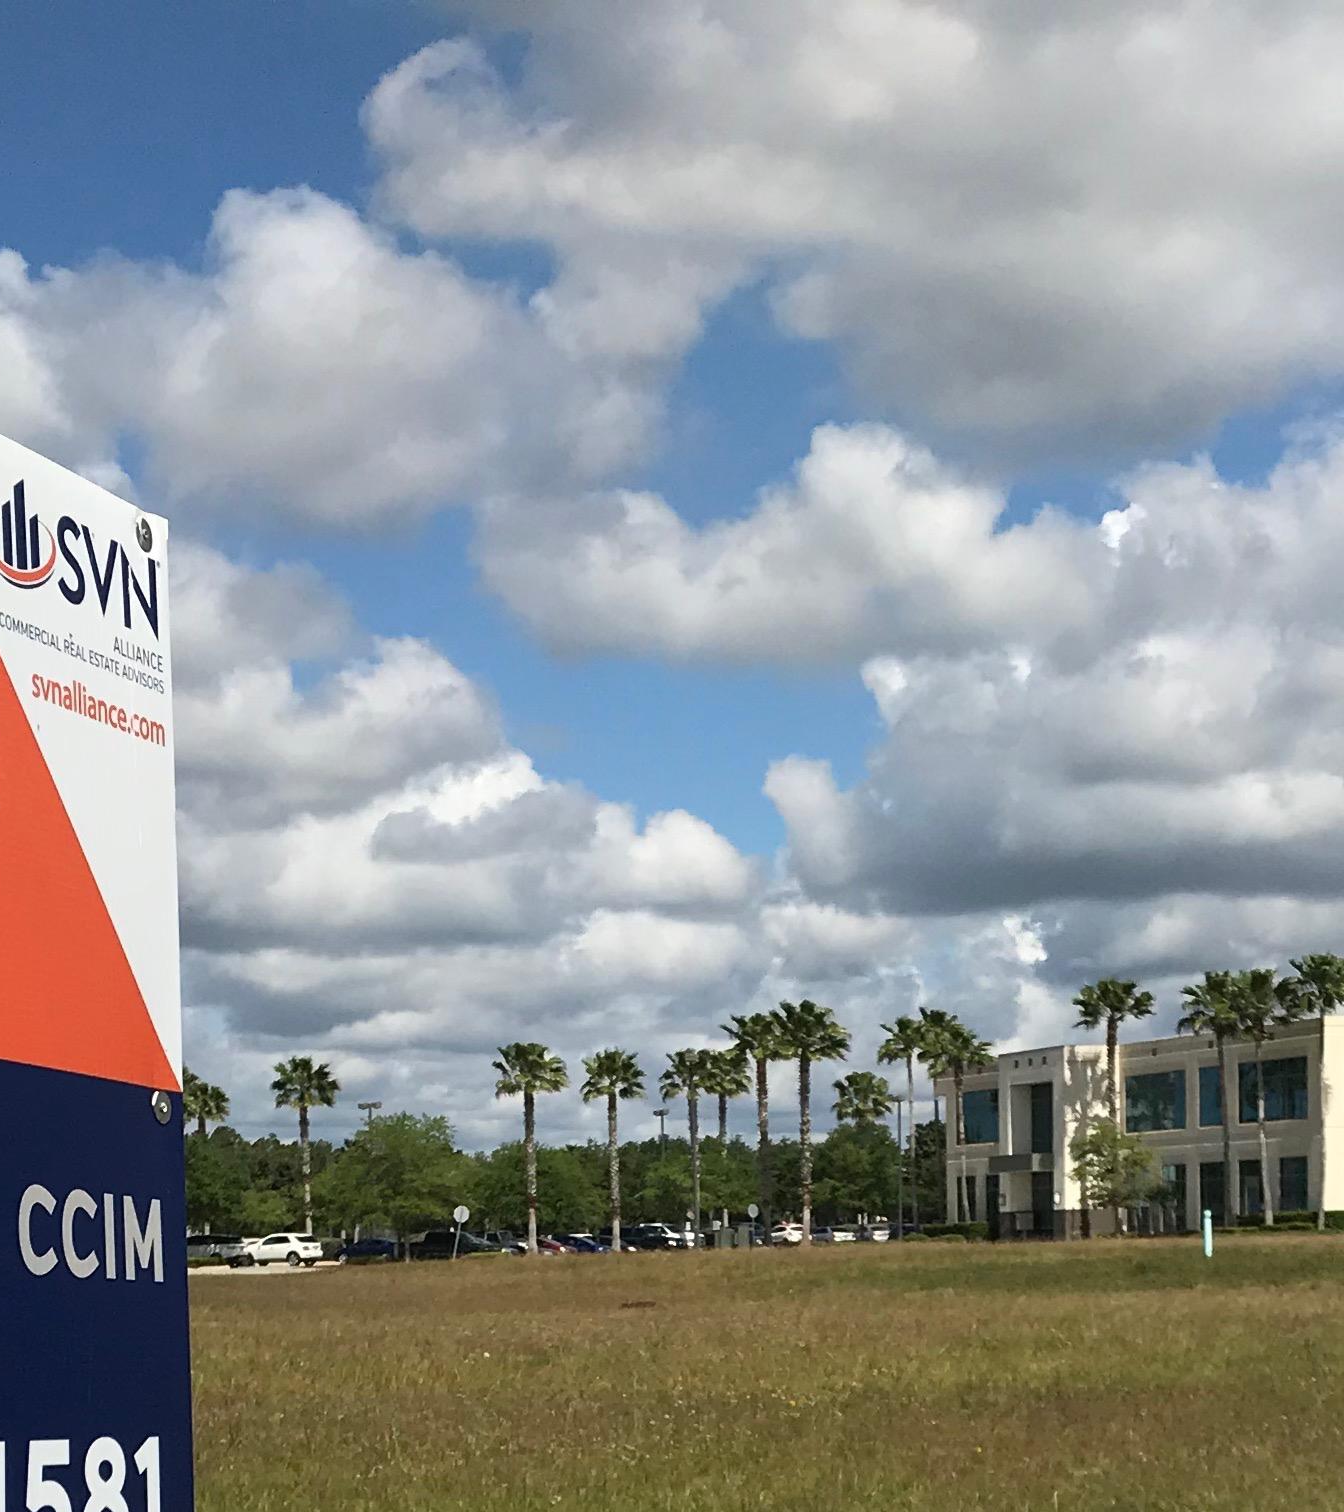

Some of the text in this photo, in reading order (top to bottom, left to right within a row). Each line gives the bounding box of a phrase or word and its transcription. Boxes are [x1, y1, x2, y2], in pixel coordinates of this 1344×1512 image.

[57, 516, 159, 642] SVN
[64, 639, 87, 663] REAL
[89, 651, 120, 677] ESTATE
[122, 664, 165, 695] ADVISORS
[113, 636, 164, 673] ALLIANCE
[32, 673, 166, 747] svnalliance.com
[18, 1184, 164, 1283] CCIM
